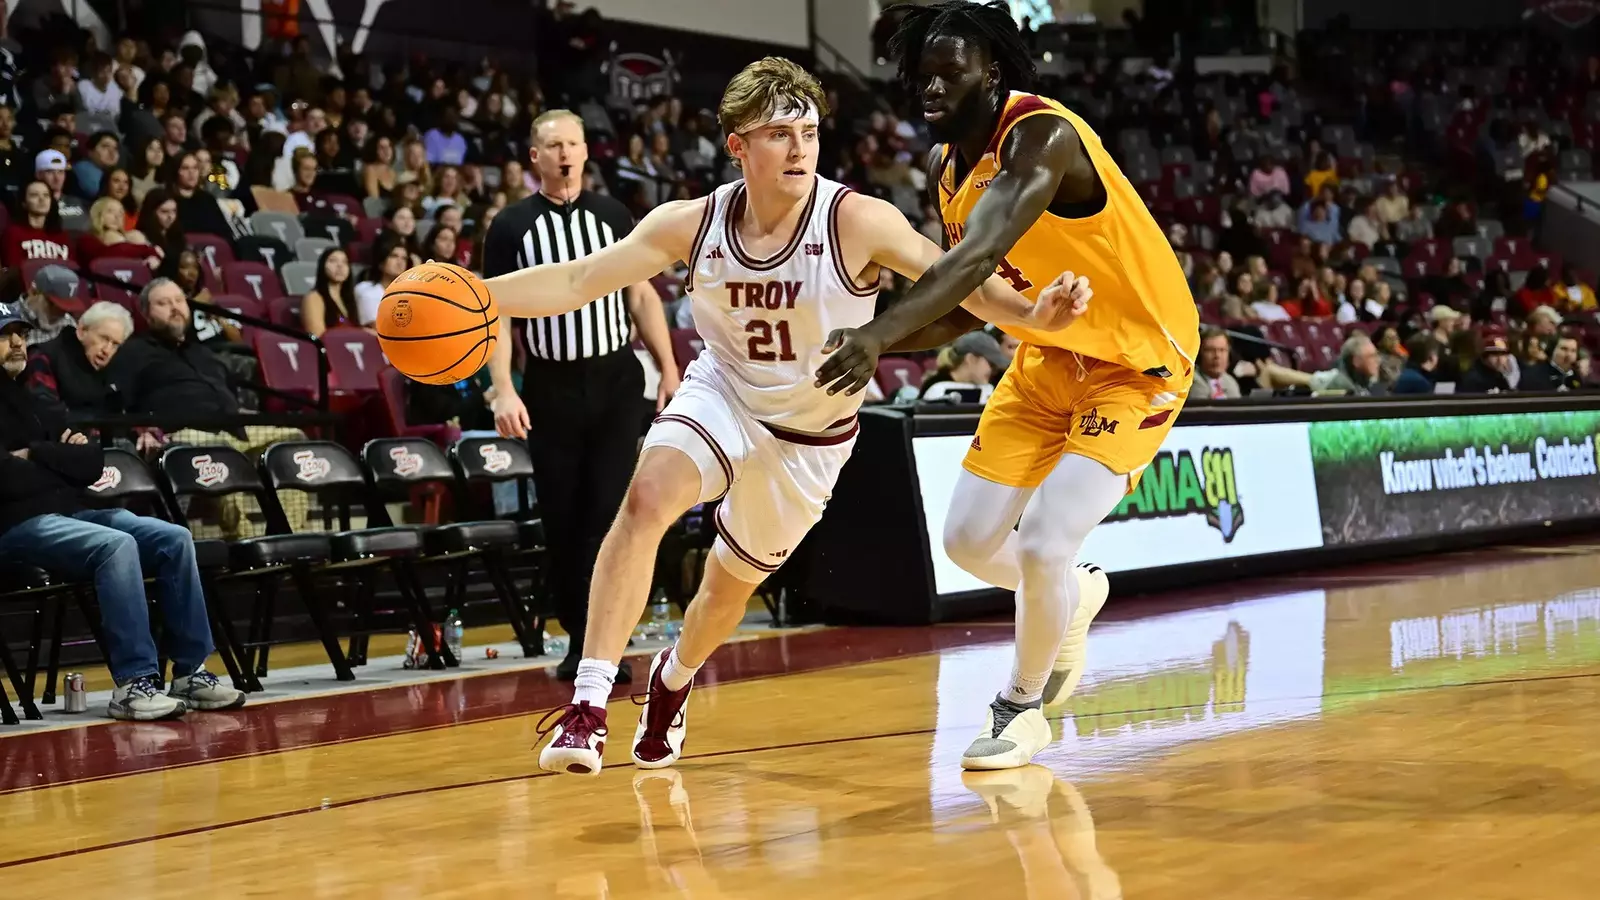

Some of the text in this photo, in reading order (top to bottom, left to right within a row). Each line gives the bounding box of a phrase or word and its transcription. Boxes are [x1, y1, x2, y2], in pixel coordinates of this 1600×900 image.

[21, 239, 69, 260] TROY
[725, 281, 804, 310] TROY
[745, 319, 797, 361] 21
[1079, 407, 1119, 437] ULM
[193, 456, 228, 486] Troy
[294, 451, 330, 480] Troy
[1380, 451, 1433, 494] Know
[1432, 447, 1487, 490] what's
[1484, 444, 1537, 485] below.
[1535, 436, 1596, 479] Contact
[1103, 450, 1206, 521] AMA
